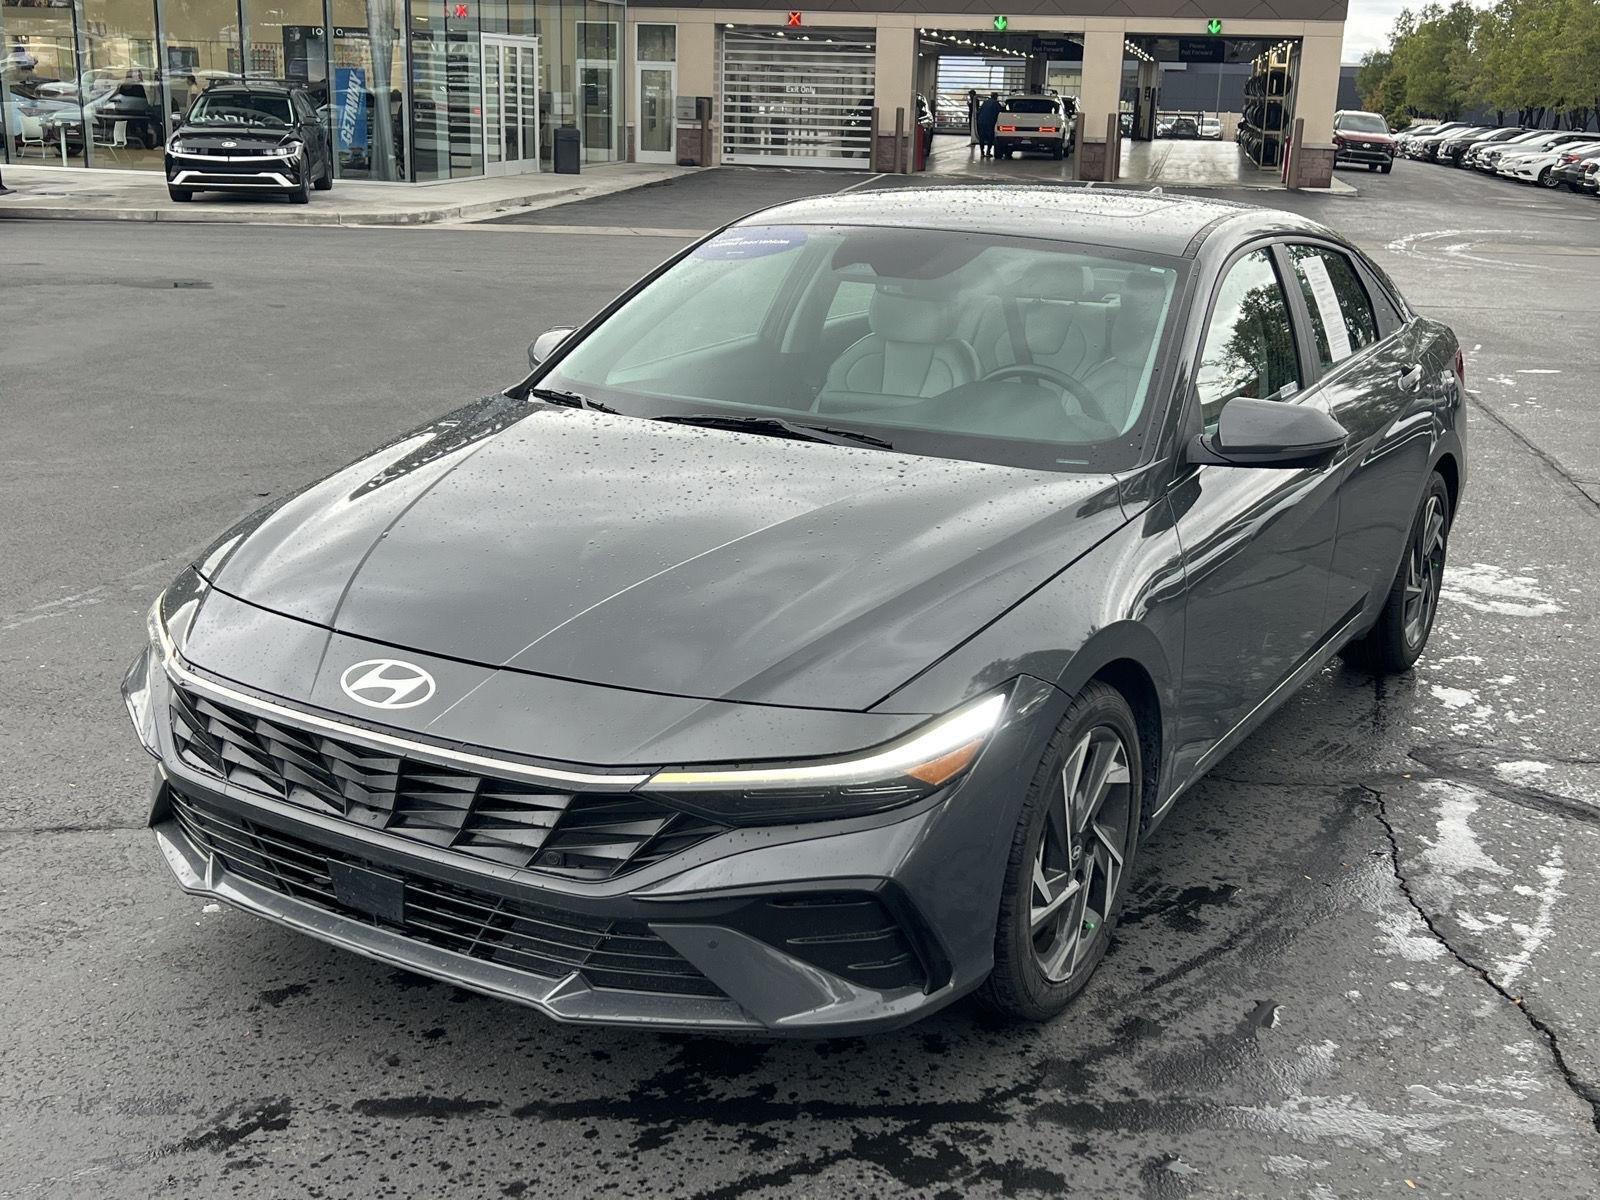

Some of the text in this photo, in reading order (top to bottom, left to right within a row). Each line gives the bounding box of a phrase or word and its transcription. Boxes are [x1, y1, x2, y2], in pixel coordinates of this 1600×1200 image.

[312, 27, 343, 37] IOIQ
[785, 84, 816, 95] Exit Only
[340, 69, 361, 146] GETAWAY
